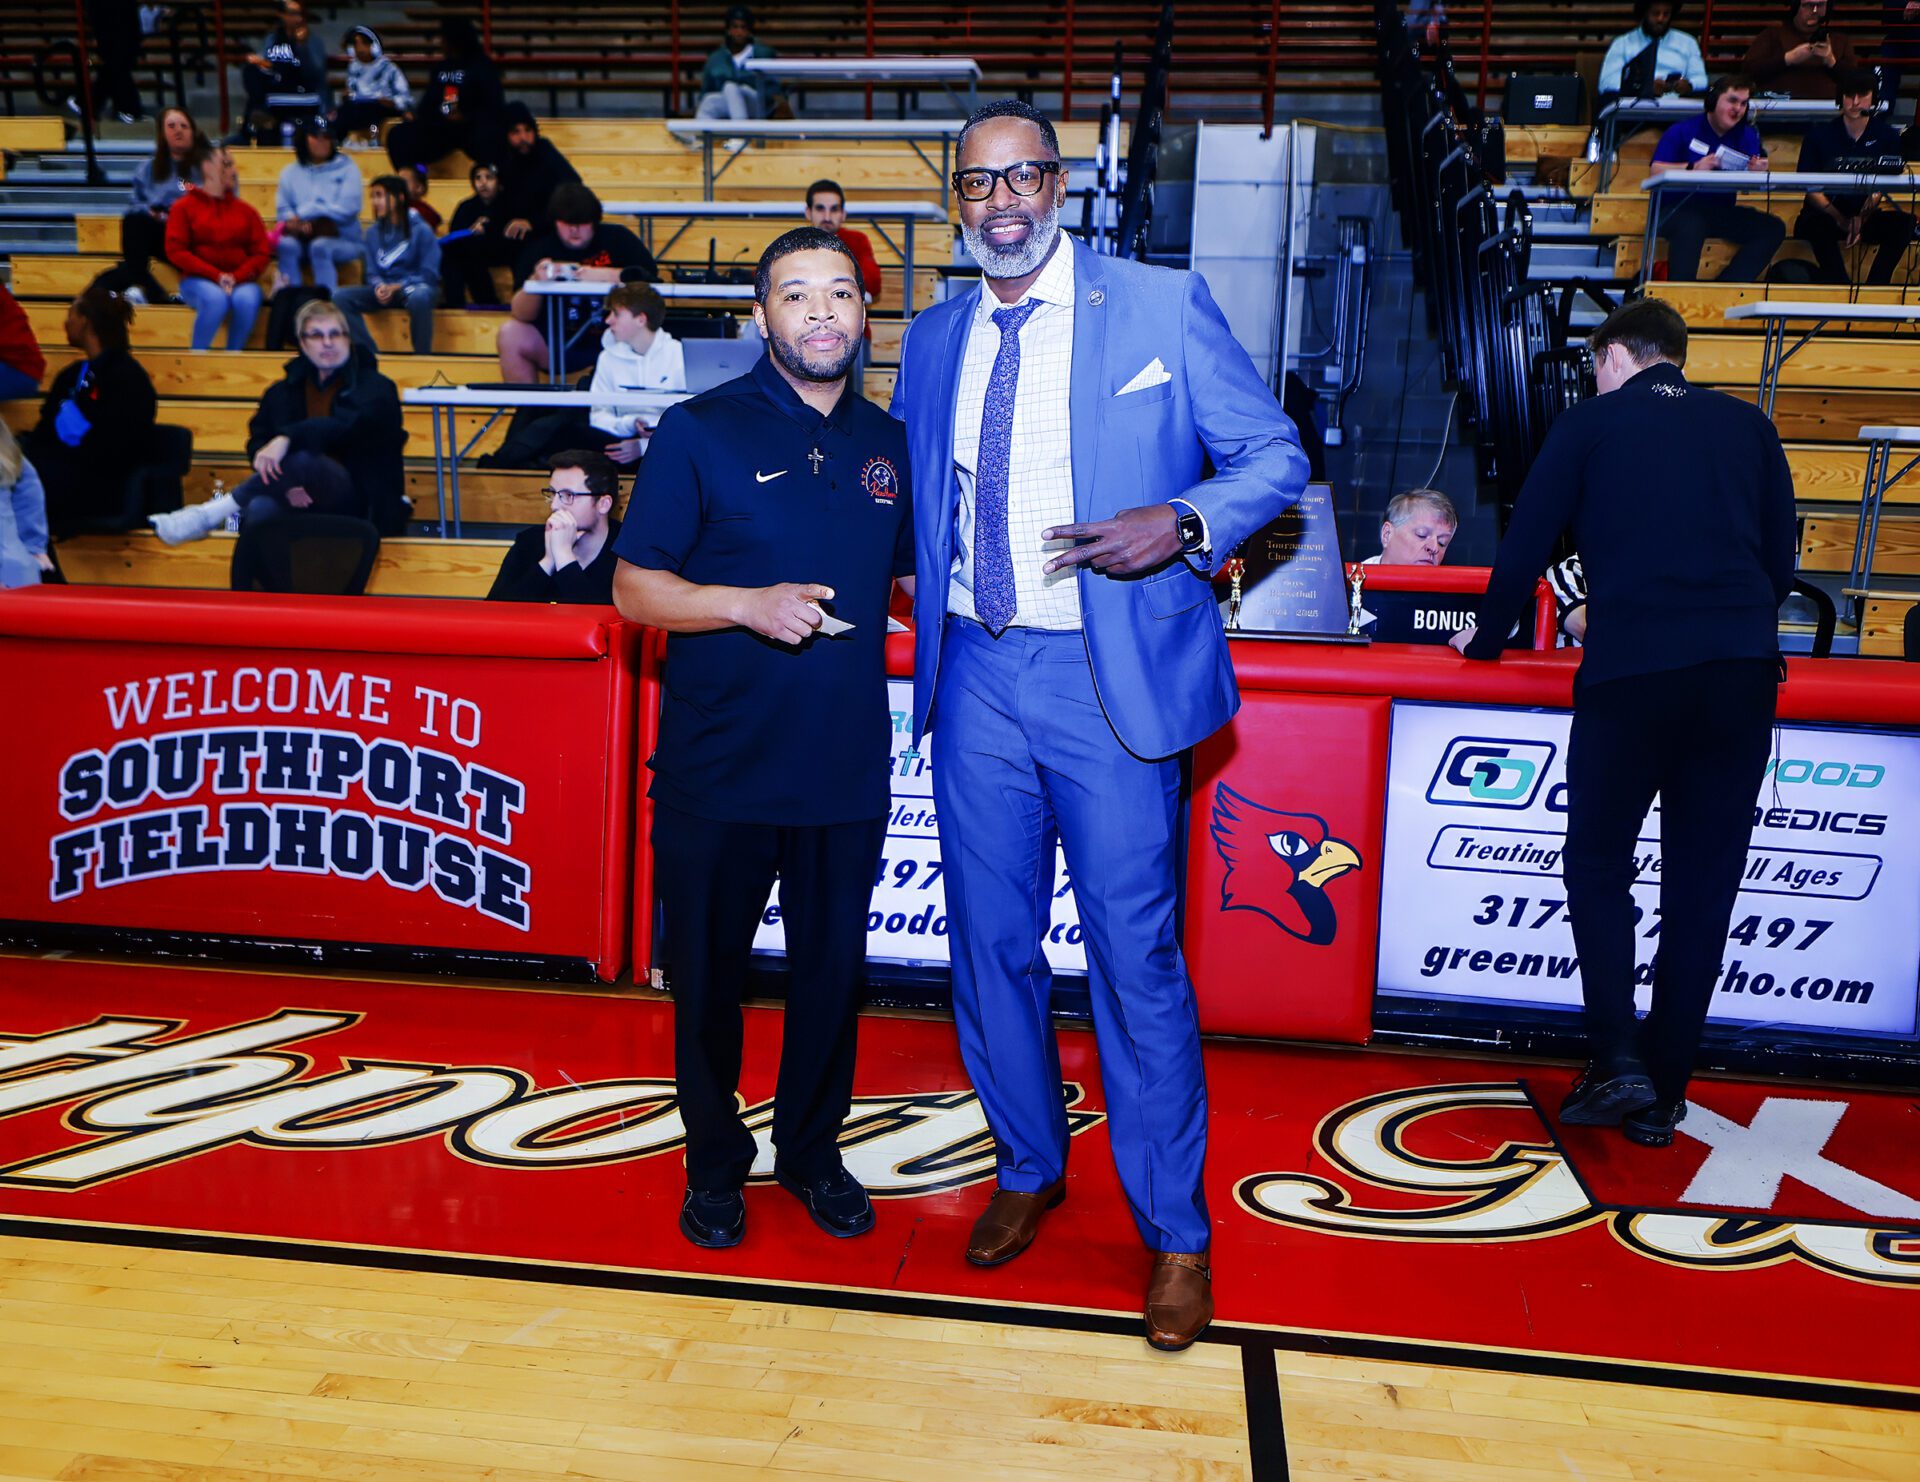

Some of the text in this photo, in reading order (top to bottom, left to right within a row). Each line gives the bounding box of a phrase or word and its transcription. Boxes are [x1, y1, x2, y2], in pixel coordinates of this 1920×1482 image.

[1414, 609, 1476, 631] BONUS
[104, 667, 481, 748] WELCOME TO
[58, 725, 525, 846] SOUTHPORT
[49, 802, 530, 931] FIELDHOUSE
[1455, 837, 1562, 871] Treating
[1772, 861, 1843, 889] Ages
